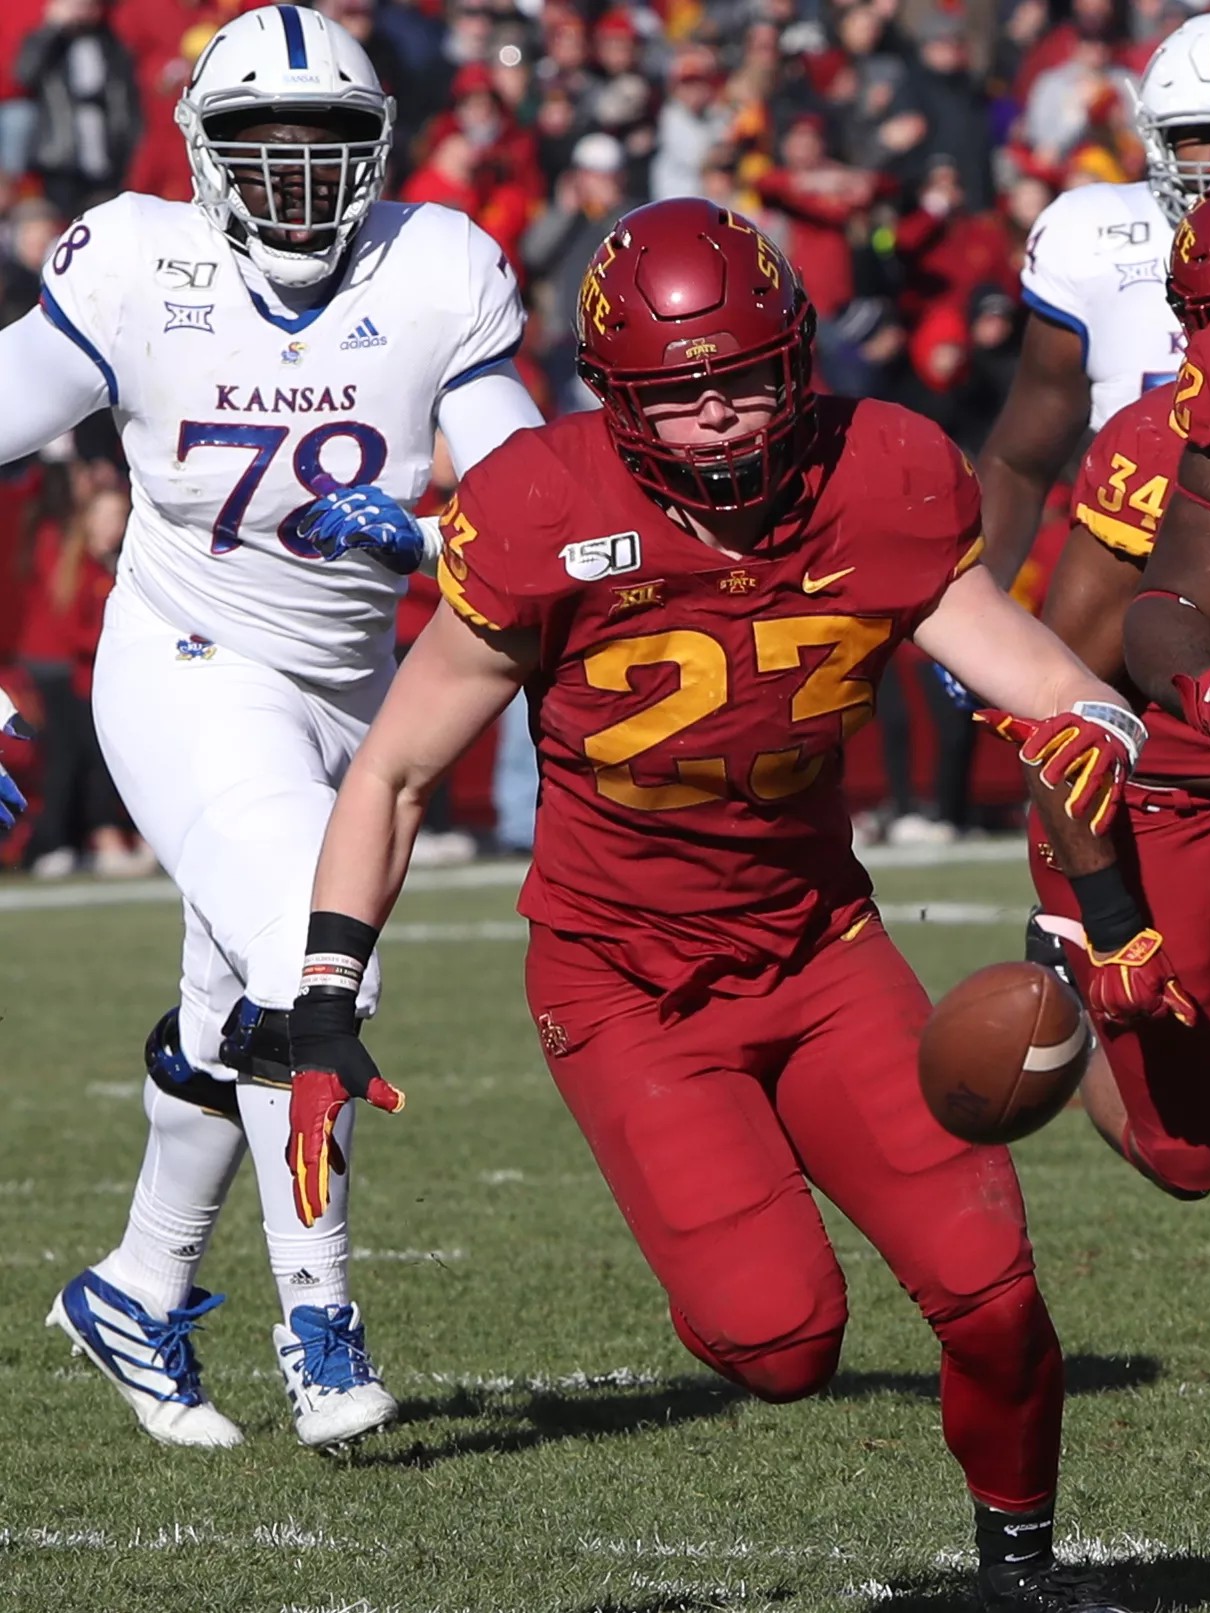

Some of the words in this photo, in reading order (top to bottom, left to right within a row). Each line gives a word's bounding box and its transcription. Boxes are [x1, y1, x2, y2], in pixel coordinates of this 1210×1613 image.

[155, 257, 218, 290] 150
[340, 334, 387, 351] adidas
[686, 342, 717, 360] STATE
[215, 384, 357, 413] KANSAS
[177, 420, 388, 560] 78
[1097, 452, 1169, 531] 34
[566, 532, 638, 580] 150
[719, 576, 758, 591] STATE
[585, 616, 893, 811] 23
